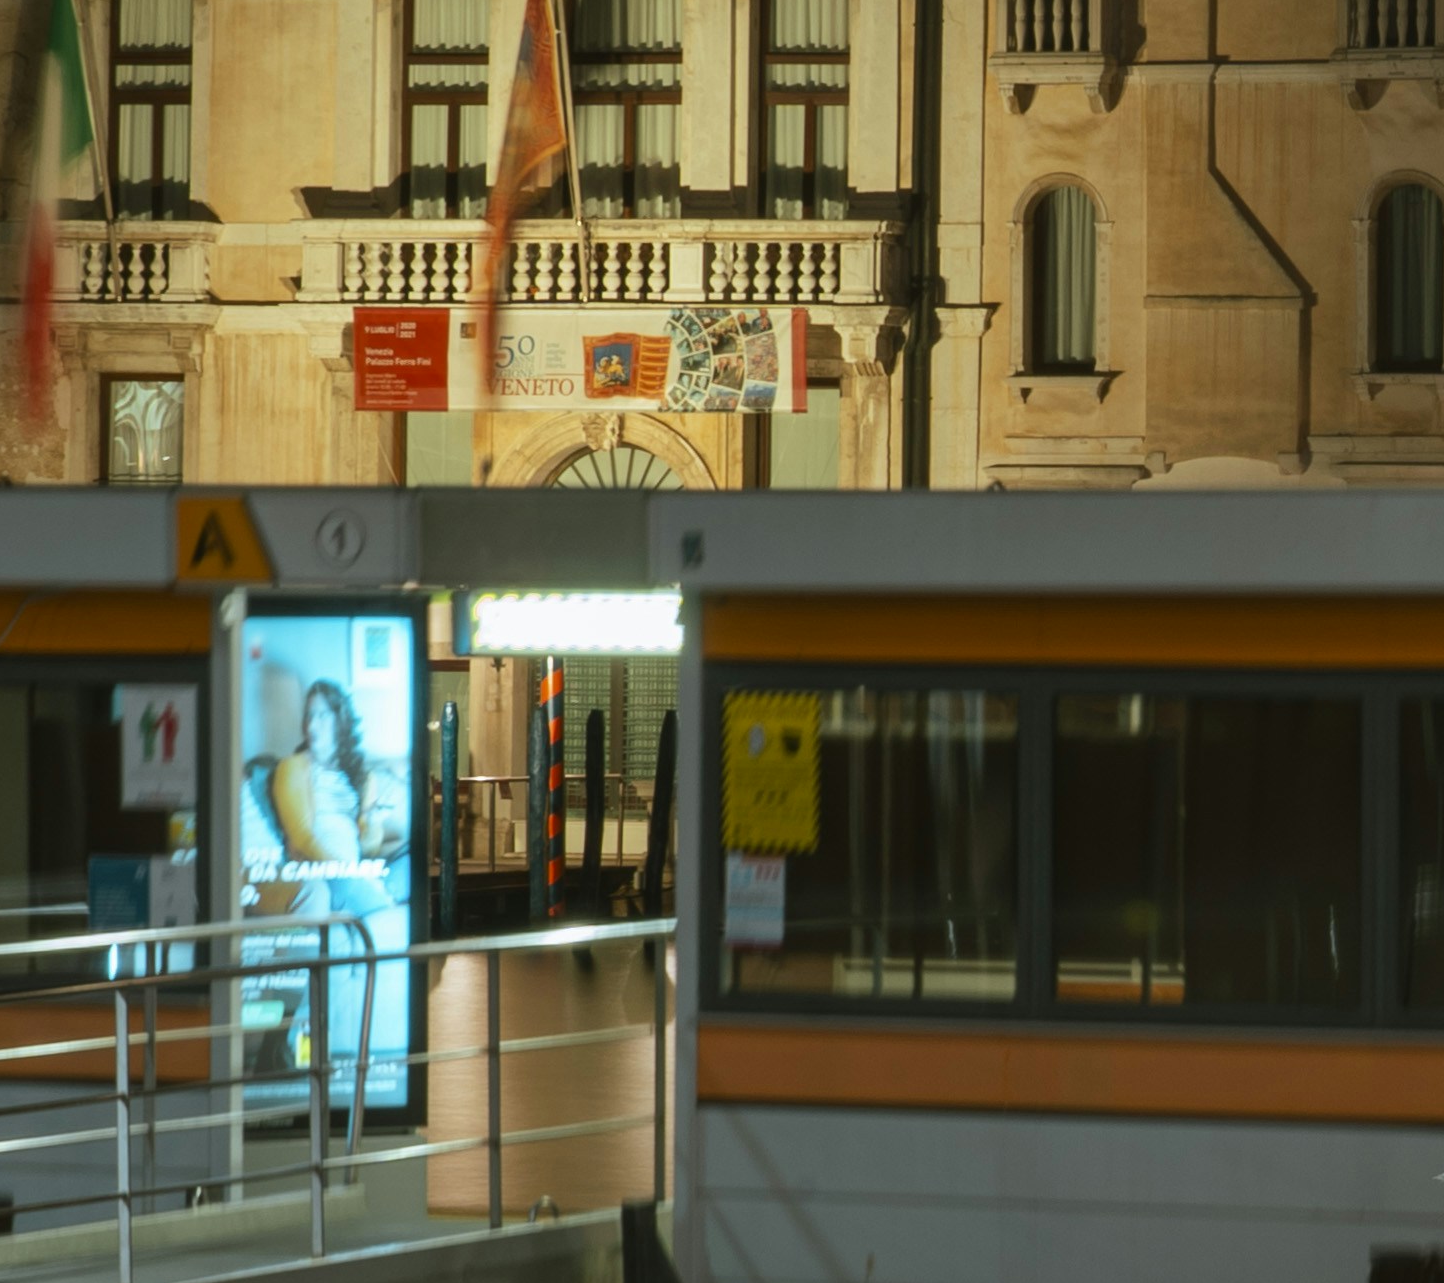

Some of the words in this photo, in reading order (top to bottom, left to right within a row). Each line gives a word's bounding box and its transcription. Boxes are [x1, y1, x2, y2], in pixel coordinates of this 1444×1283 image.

[364, 347, 394, 356] Venezia
[365, 357, 394, 366] Palazzo
[417, 357, 432, 366] Fini
[487, 378, 574, 396] VENETO
[191, 509, 235, 568] A
